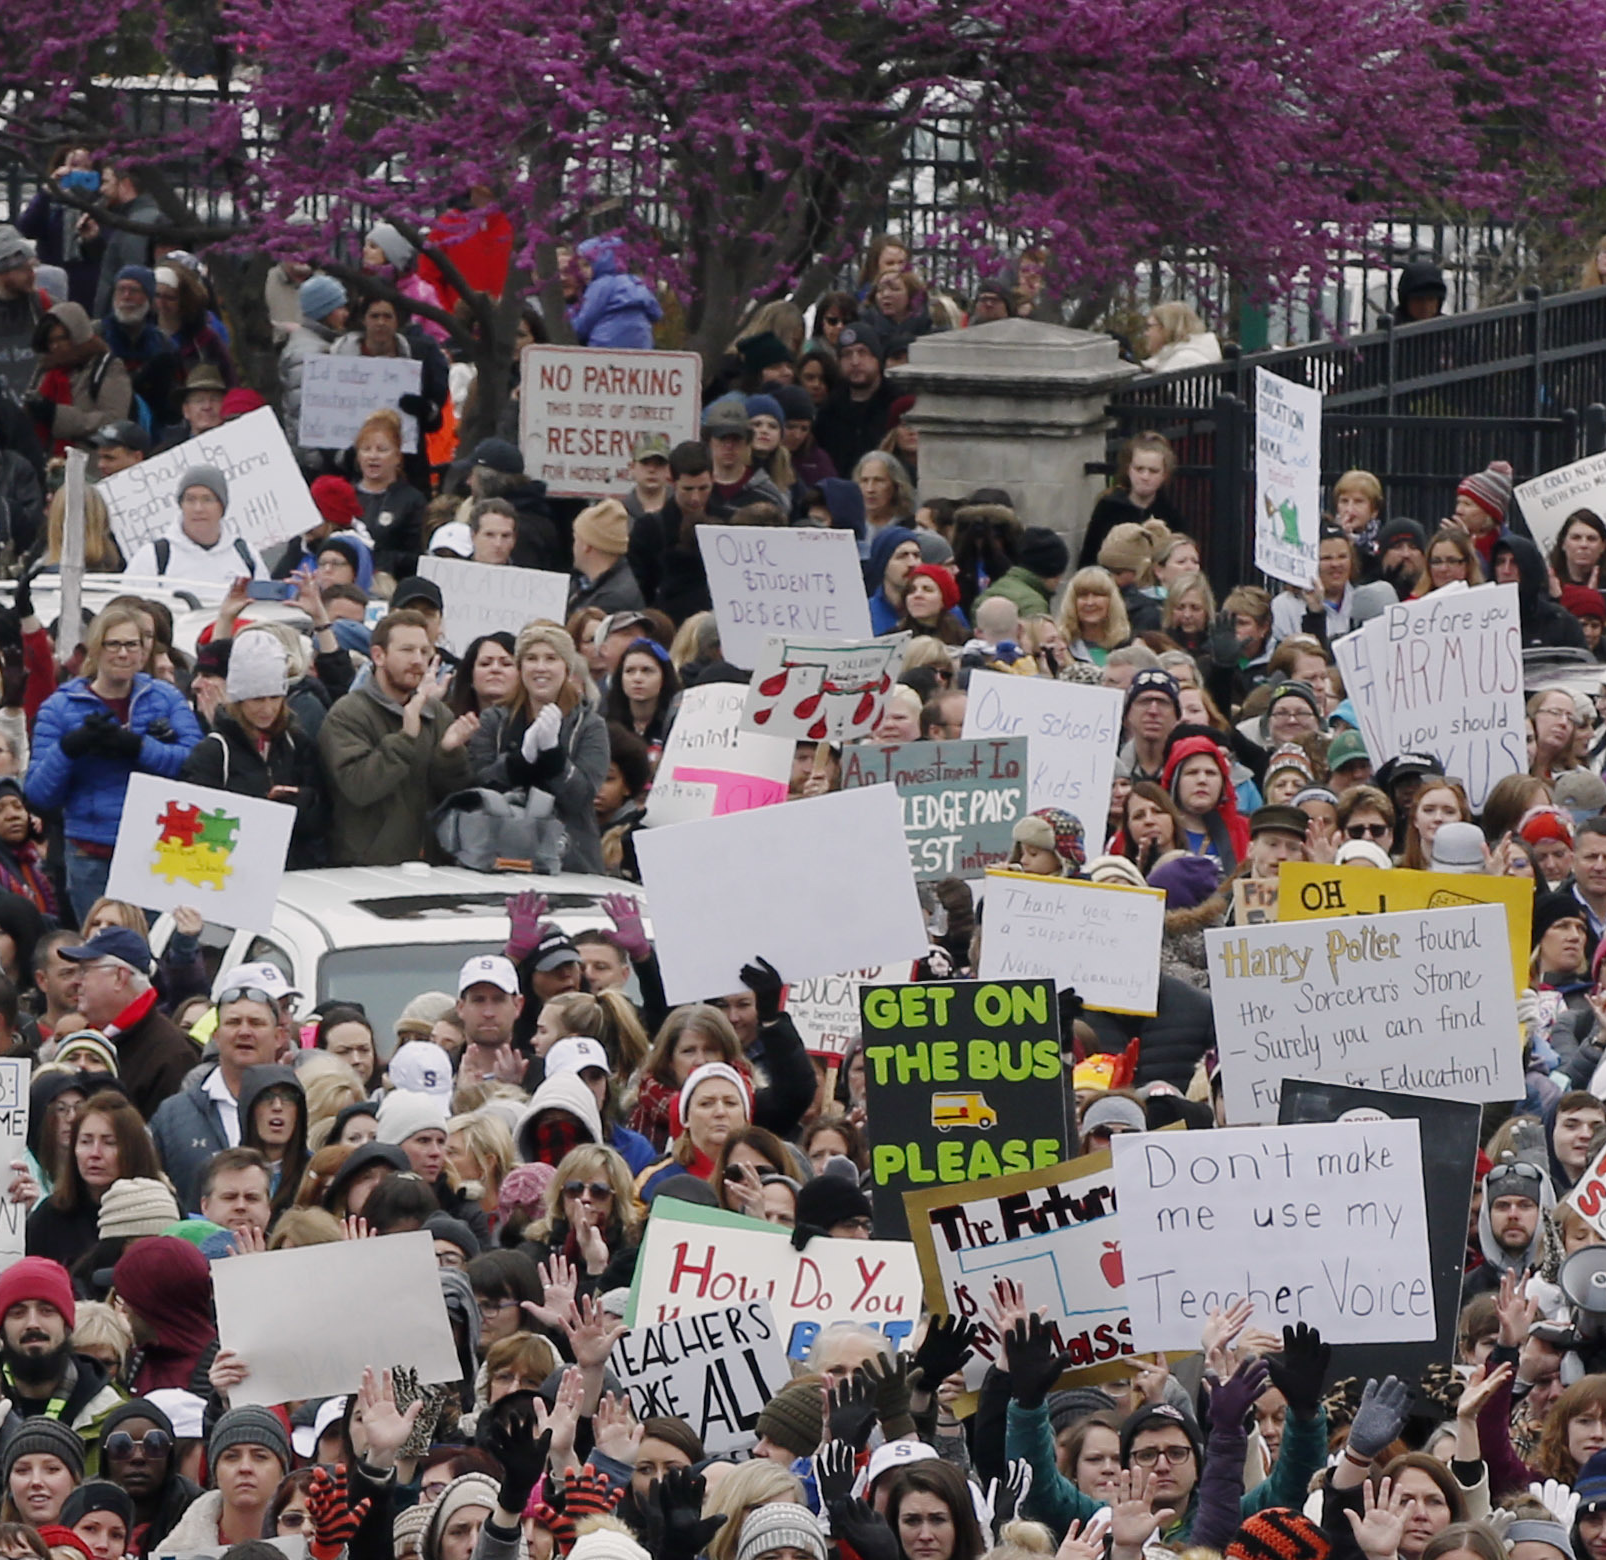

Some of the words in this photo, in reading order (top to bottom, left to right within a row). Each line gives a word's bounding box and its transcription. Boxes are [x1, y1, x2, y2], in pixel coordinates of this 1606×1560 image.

[541, 364, 572, 392] NO
[583, 366, 682, 396] PARKING
[546, 402, 571, 416] THIS
[578, 403, 604, 418] SIDE
[609, 405, 626, 418] OF
[629, 405, 675, 421] STREET
[548, 427, 670, 456] RESERV
[863, 985, 948, 1030] GET
[974, 985, 1049, 1026] ON
[865, 1043, 960, 1085] THE
[967, 1038, 1062, 1083] BUS
[872, 1138, 1060, 1186] PLEASE
[1145, 1143, 1296, 1190] Don't
[1316, 1135, 1396, 1178] make
[1156, 1205, 1217, 1231] me
[1253, 1200, 1323, 1229] use
[1345, 1201, 1404, 1237] my
[1137, 1268, 1315, 1325] Teacher
[1321, 1255, 1432, 1318] Voice
